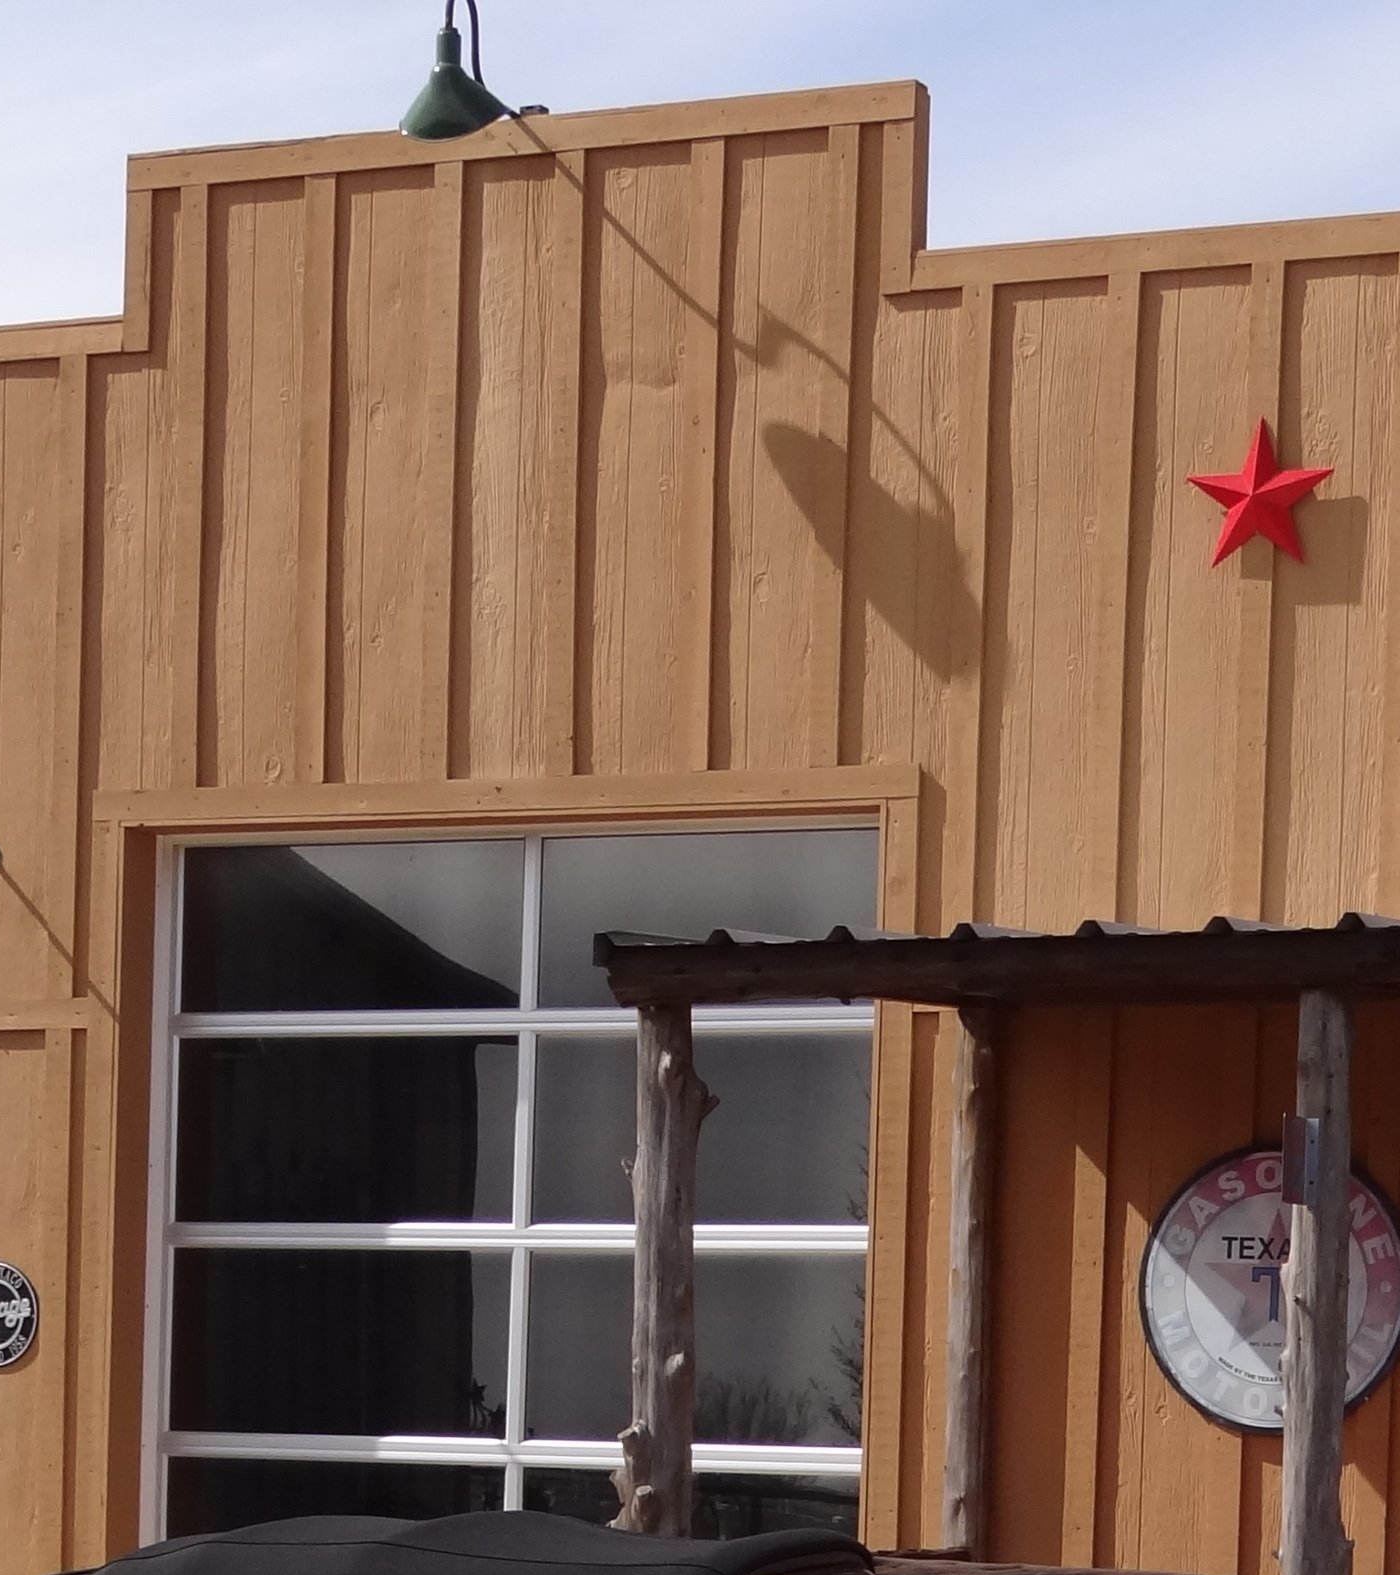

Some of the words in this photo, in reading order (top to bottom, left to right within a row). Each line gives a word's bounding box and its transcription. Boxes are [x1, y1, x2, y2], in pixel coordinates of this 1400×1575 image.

[1166, 1159, 1393, 1264] GASONE
[1221, 1236, 1292, 1260] TEXA
[1244, 1371, 1257, 1380] THE
